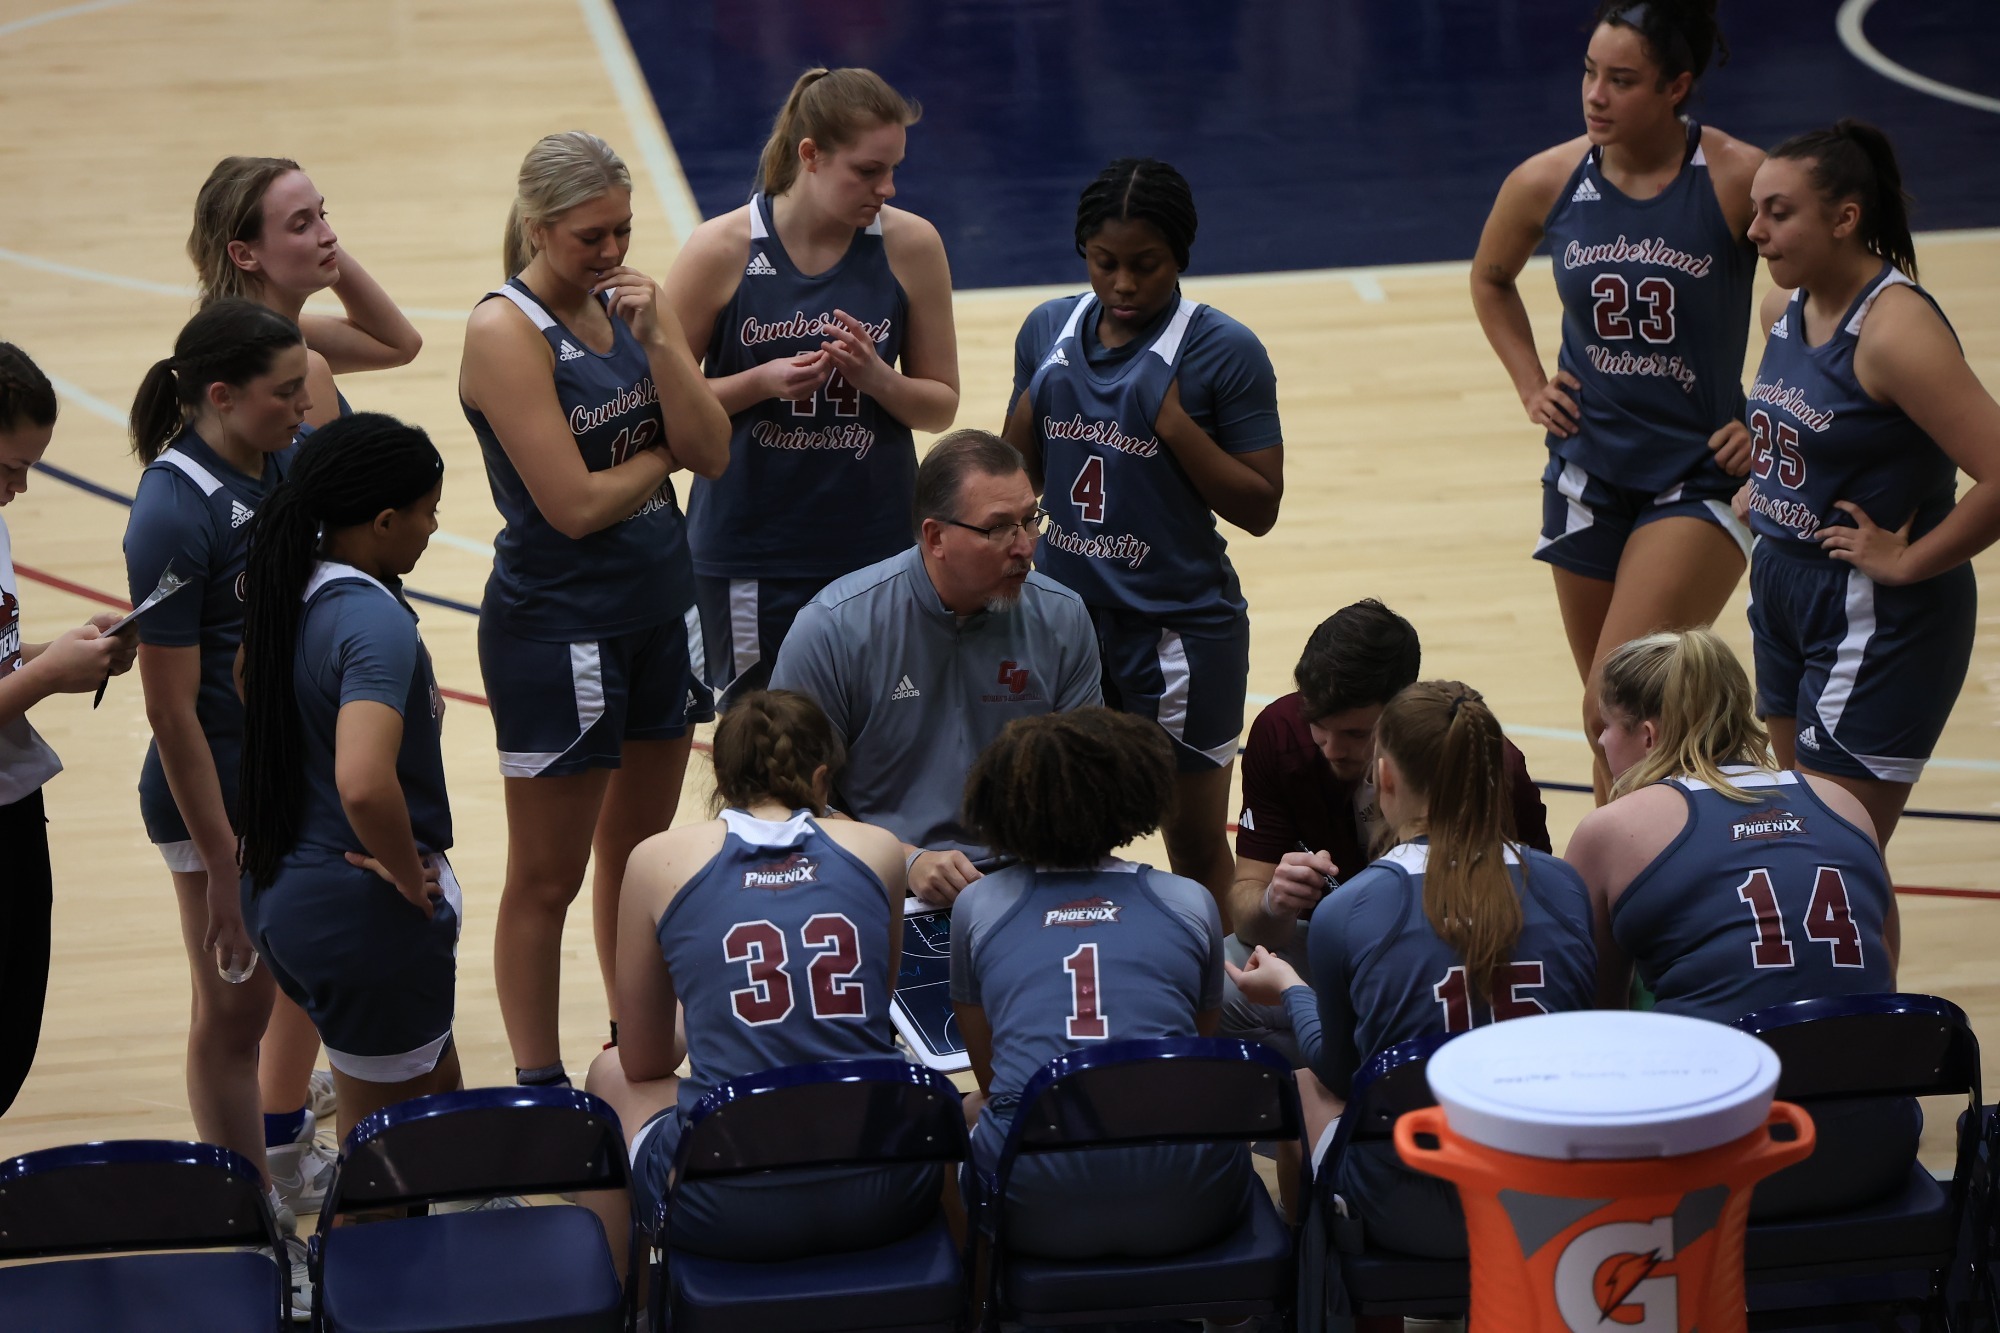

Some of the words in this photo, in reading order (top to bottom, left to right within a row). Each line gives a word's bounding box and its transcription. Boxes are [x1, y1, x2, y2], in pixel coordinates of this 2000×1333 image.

[746, 267, 777, 276] adidas
[1564, 234, 1712, 278] Cumberland
[1591, 273, 1675, 344] 23
[752, 420, 875, 461] University
[1751, 409, 1806, 490] 25
[1070, 455, 1106, 524] 4
[1737, 866, 1865, 969] 14
[722, 913, 867, 1028] 32
[1063, 943, 1109, 1040] 1
[1554, 1216, 1678, 1333] G
